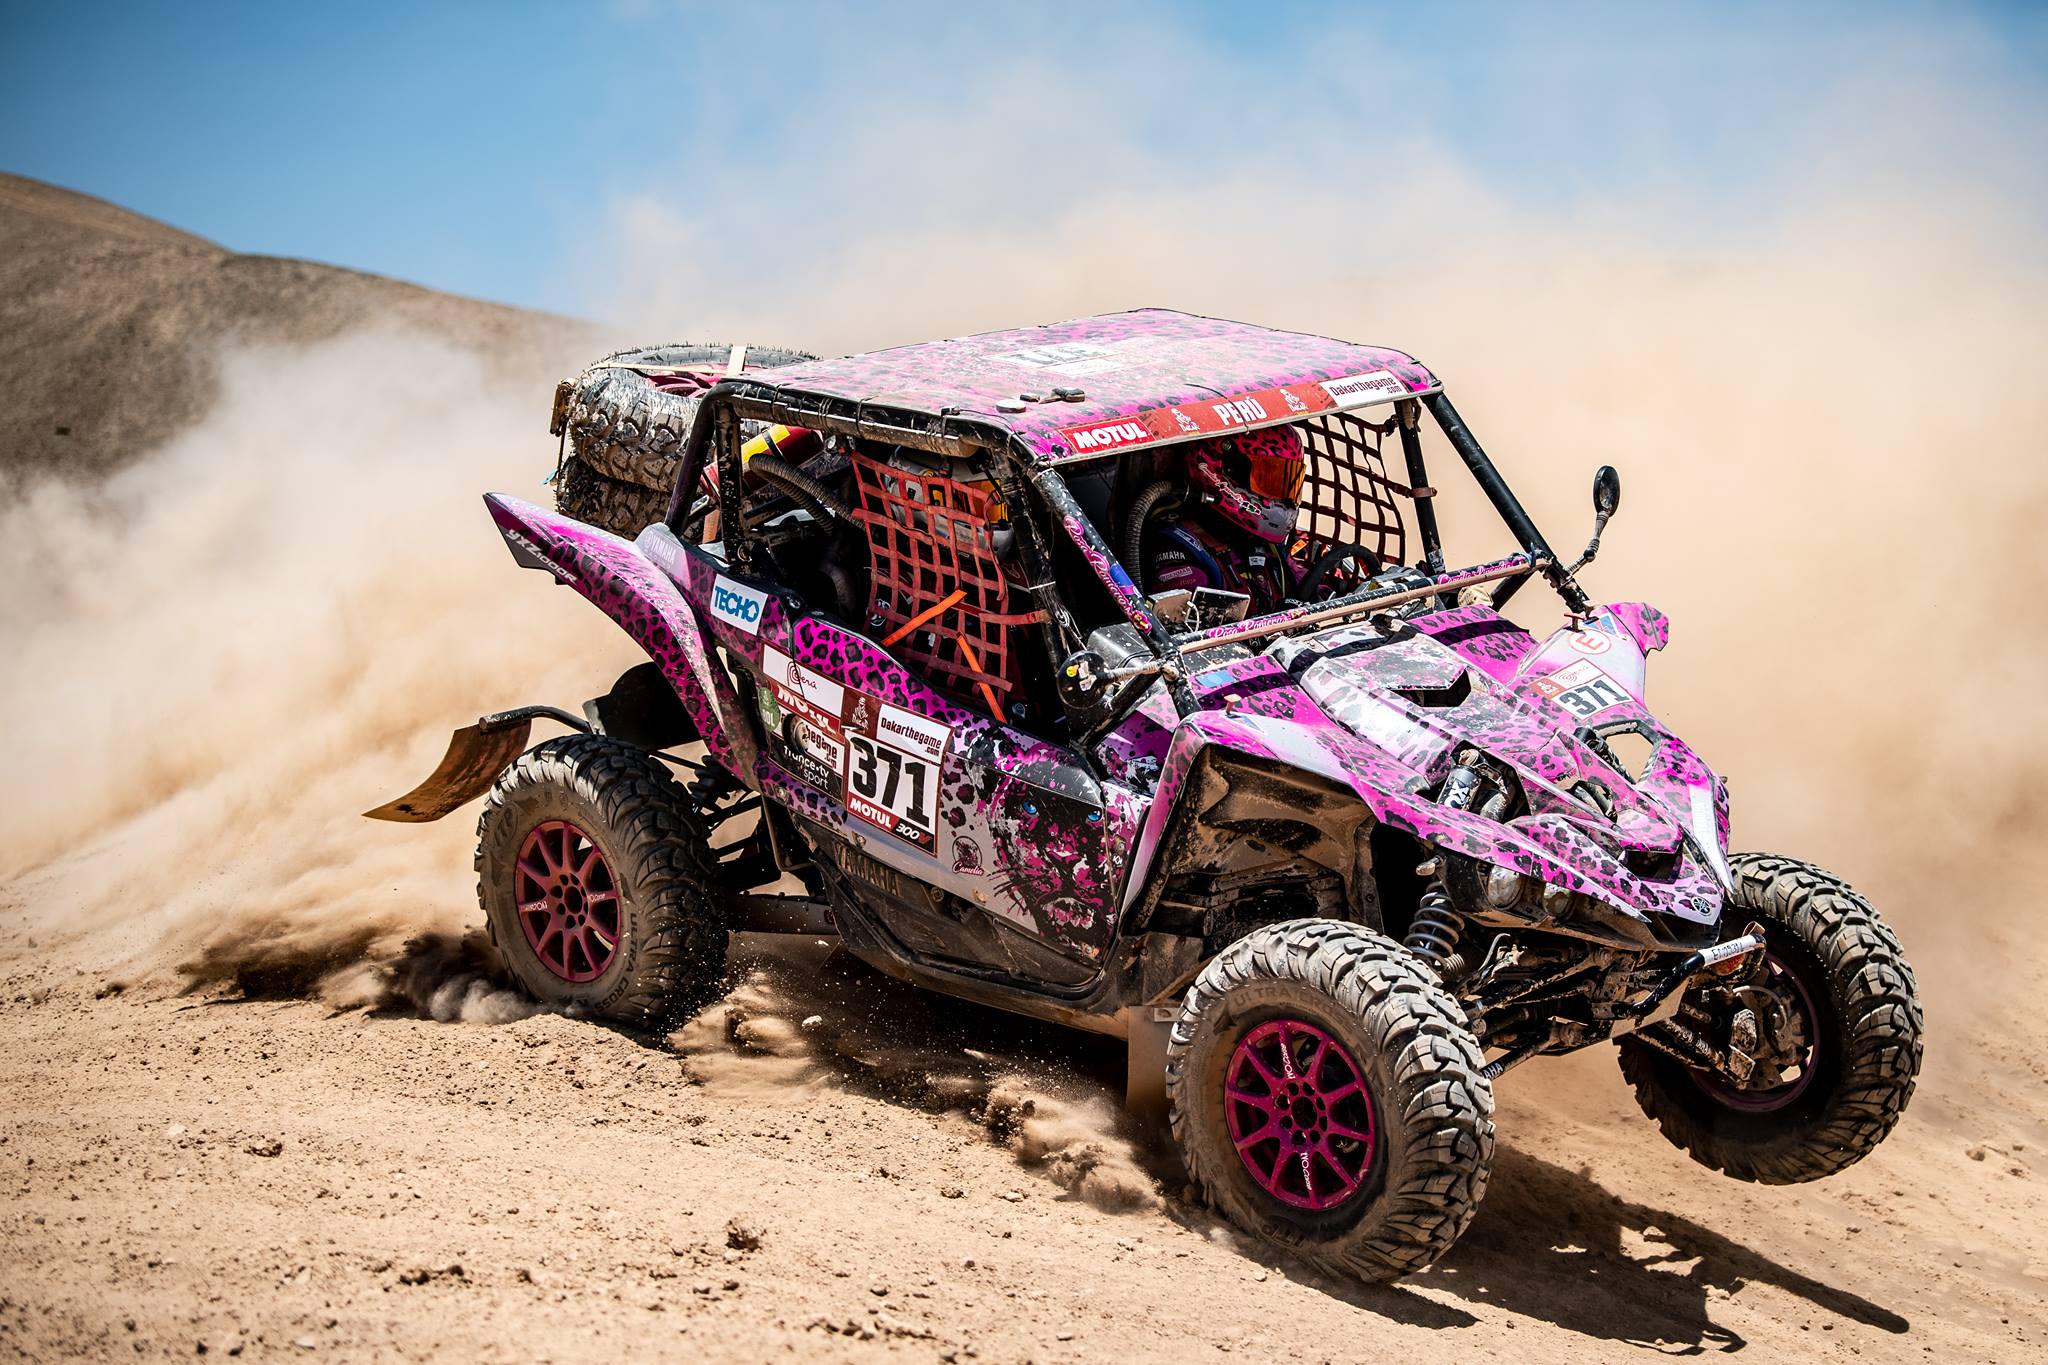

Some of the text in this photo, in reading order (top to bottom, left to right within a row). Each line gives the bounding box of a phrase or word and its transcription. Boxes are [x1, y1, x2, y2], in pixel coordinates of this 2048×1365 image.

[1330, 377, 1397, 396] Dakarthegame
[1212, 396, 1268, 426] PERÚ
[1074, 421, 1147, 449] MOTUL
[715, 586, 760, 623] TECHO
[1560, 680, 1630, 715] 371
[881, 717, 942, 748] Dakarthegame
[925, 746, 940, 757] .com
[804, 769, 829, 790] sport
[850, 736, 930, 829] 371
[850, 798, 931, 843] MOTUL 300V
[953, 862, 983, 875] Camelia
[1483, 1062, 1504, 1078] AHA
